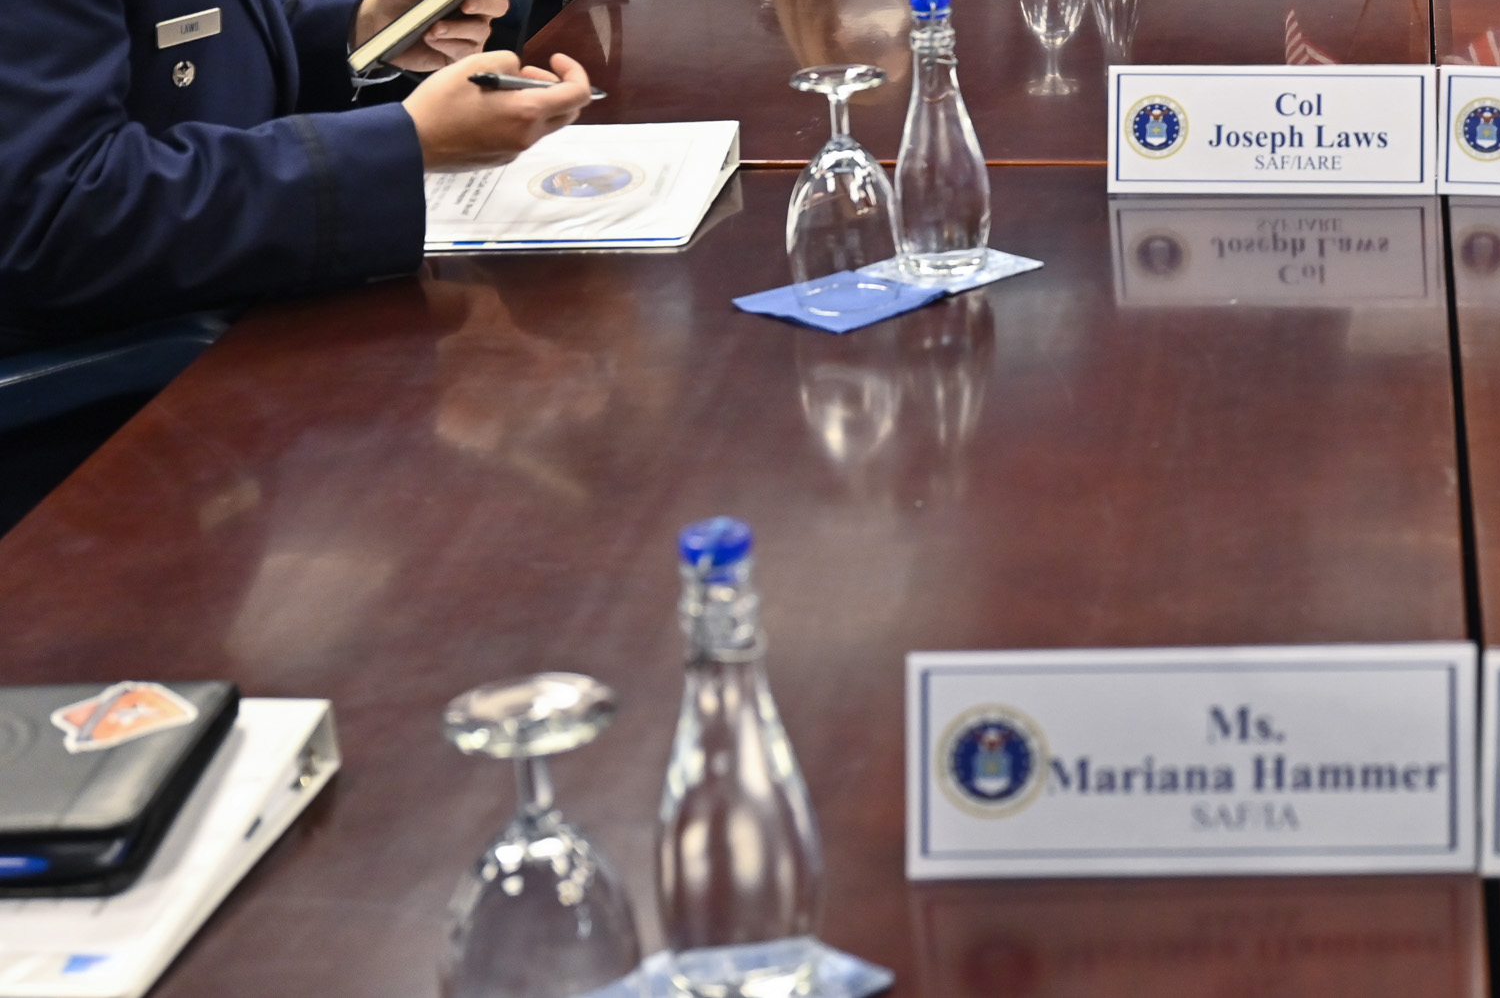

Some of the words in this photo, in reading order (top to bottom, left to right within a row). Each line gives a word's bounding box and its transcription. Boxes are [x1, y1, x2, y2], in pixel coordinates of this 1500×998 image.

[1275, 92, 1323, 116] Col
[1208, 124, 1304, 154] Joseph
[1315, 124, 1389, 149] Laws
[1254, 155, 1343, 171] SAF/IARE
[1206, 705, 1286, 743] Ms.
[1048, 755, 1235, 795] Mariana
[1251, 754, 1447, 792] Hammer
